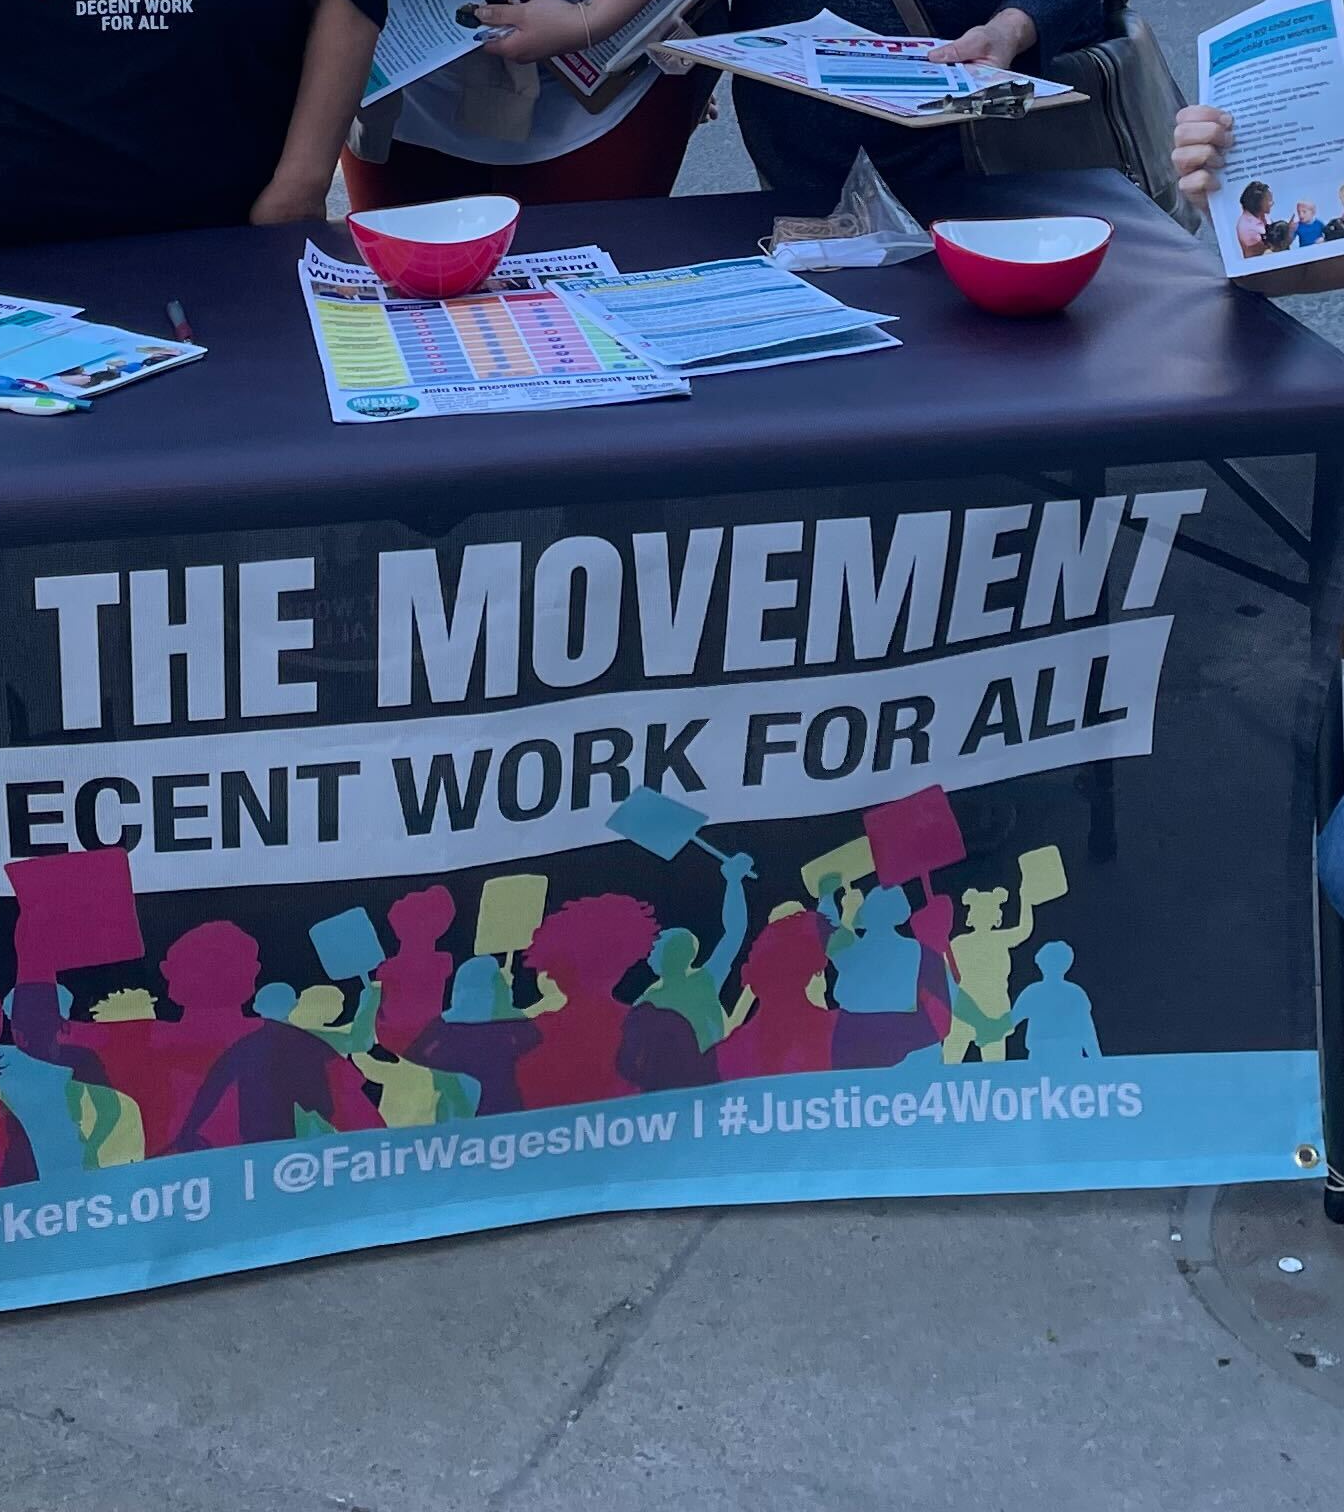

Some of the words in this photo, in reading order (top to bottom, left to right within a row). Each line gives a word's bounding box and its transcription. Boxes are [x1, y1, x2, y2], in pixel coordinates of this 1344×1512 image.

[101, 15, 134, 31] FOR
[138, 15, 169, 30] ALL
[307, 266, 384, 286] Where
[531, 261, 599, 276] stand
[310, 252, 367, 274] Decent
[34, 556, 319, 730] THE
[377, 487, 1208, 708] MOVEMENT
[391, 718, 712, 837] WORK
[740, 695, 937, 788] FOR
[959, 655, 1130, 755] ALL
[272, 1107, 677, 1195] @FairWagesNow
[718, 1076, 1143, 1140] #Justice4Workers
